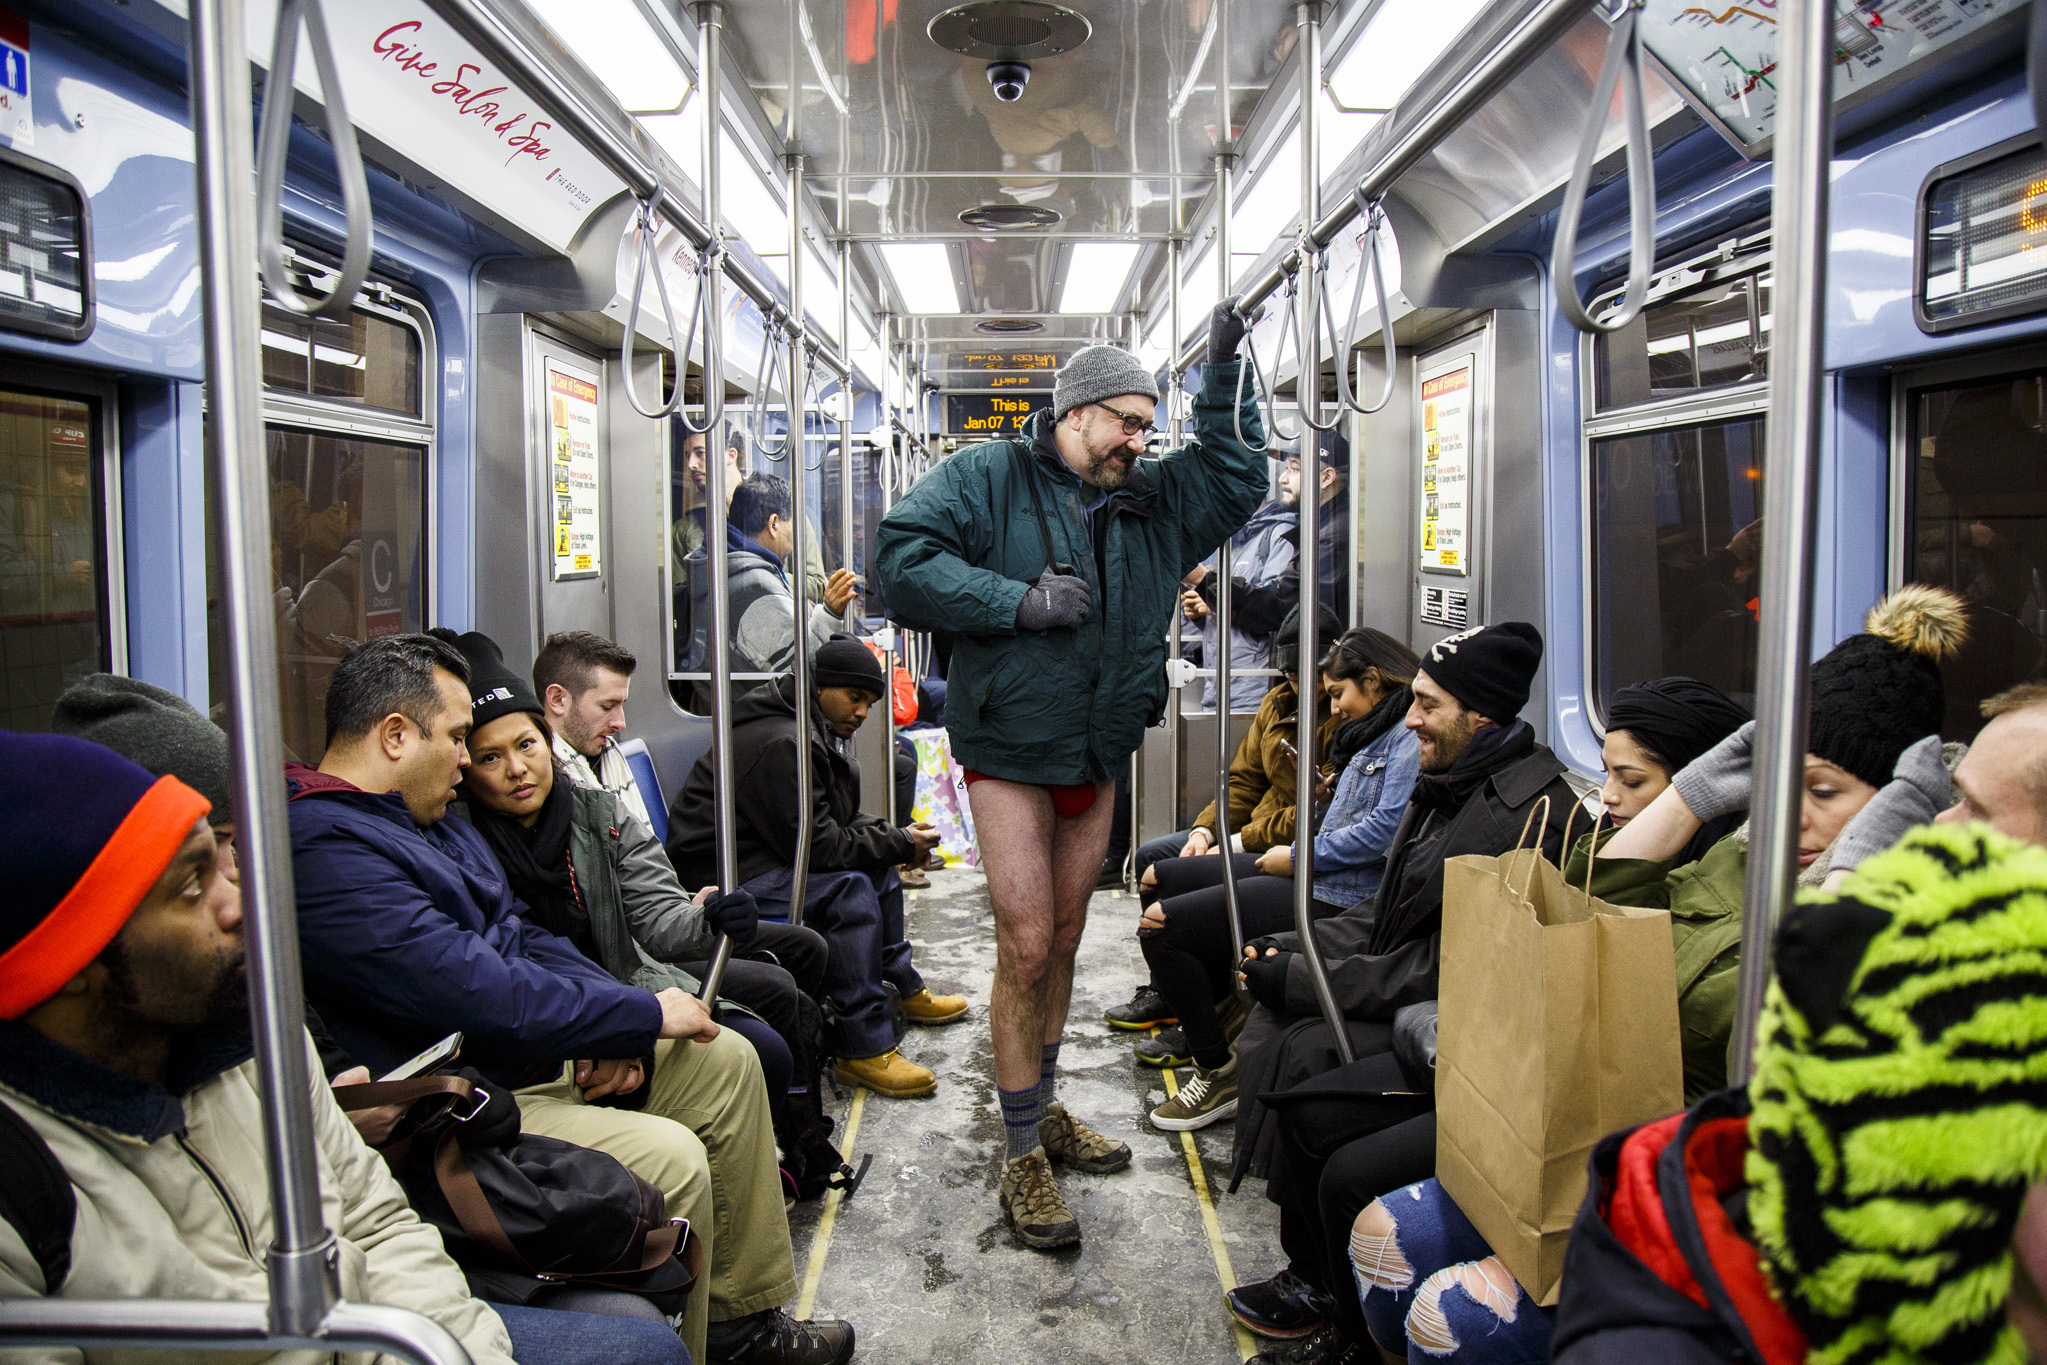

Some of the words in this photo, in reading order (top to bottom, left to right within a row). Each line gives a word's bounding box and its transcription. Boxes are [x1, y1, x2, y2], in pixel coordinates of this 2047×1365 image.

[373, 20, 437, 77] Give
[432, 63, 508, 126] Salon
[494, 113, 527, 138] &
[505, 121, 551, 167] Spa
[554, 174, 568, 186] THE
[565, 182, 577, 194] RED
[574, 190, 591, 204] DOOR
[556, 373, 567, 390] Case
[573, 380, 596, 404] Emergency
[1443, 371, 1468, 390] Emergency
[991, 398, 1017, 412] This
[1018, 398, 1030, 412] is
[964, 416, 986, 429] Jan
[988, 416, 1004, 429] 07
[371, 538, 392, 593] C
